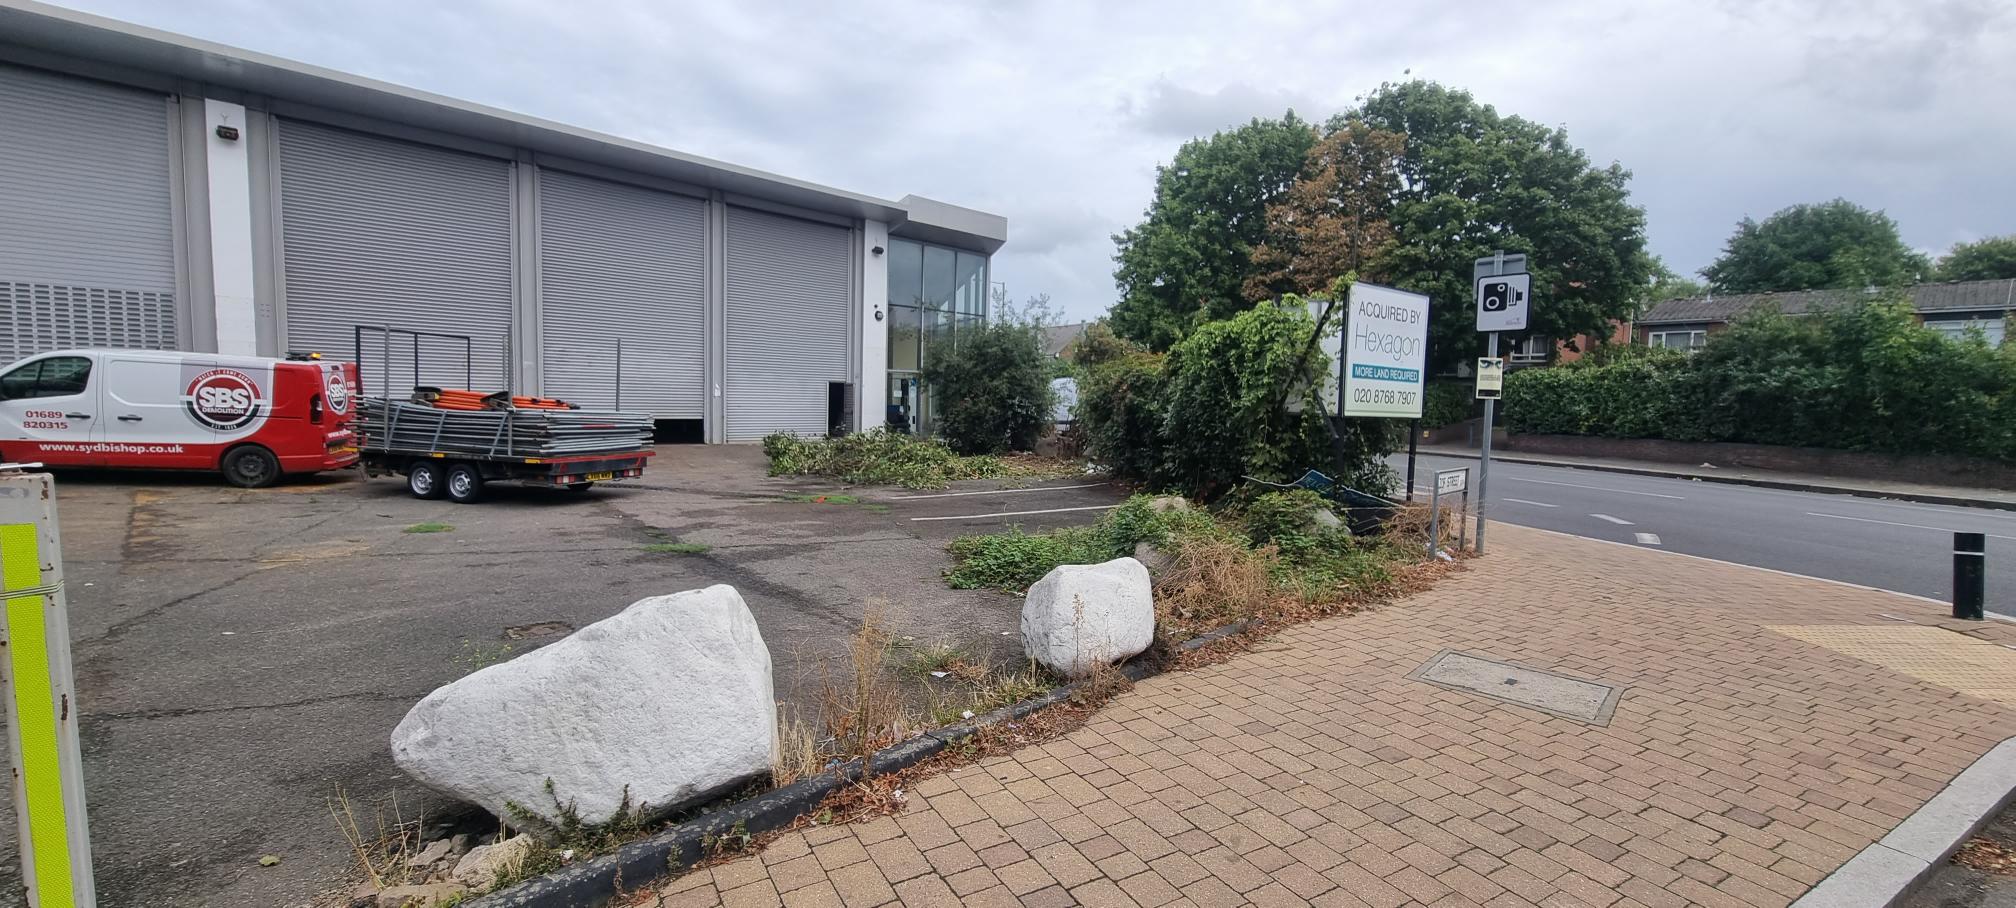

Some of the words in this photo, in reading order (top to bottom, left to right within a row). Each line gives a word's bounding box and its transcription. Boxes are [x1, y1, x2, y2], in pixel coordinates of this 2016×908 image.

[1359, 300, 1409, 322] ACQUIRED
[1411, 310, 1421, 325] BY
[1355, 322, 1421, 361] Hexagon
[1354, 366, 1373, 378] MORE
[1374, 369, 1390, 379] LAND
[1390, 371, 1418, 381] REQUIRED
[199, 386, 249, 409] SBS
[330, 384, 344, 398] SBS
[1354, 388, 1371, 403] 020
[1374, 389, 1394, 404] 8768
[1397, 391, 1417, 405] 7907
[25, 410, 62, 419] 01689
[23, 421, 68, 429] 820315
[39, 443, 183, 454] www.sydbishop.co.uk
